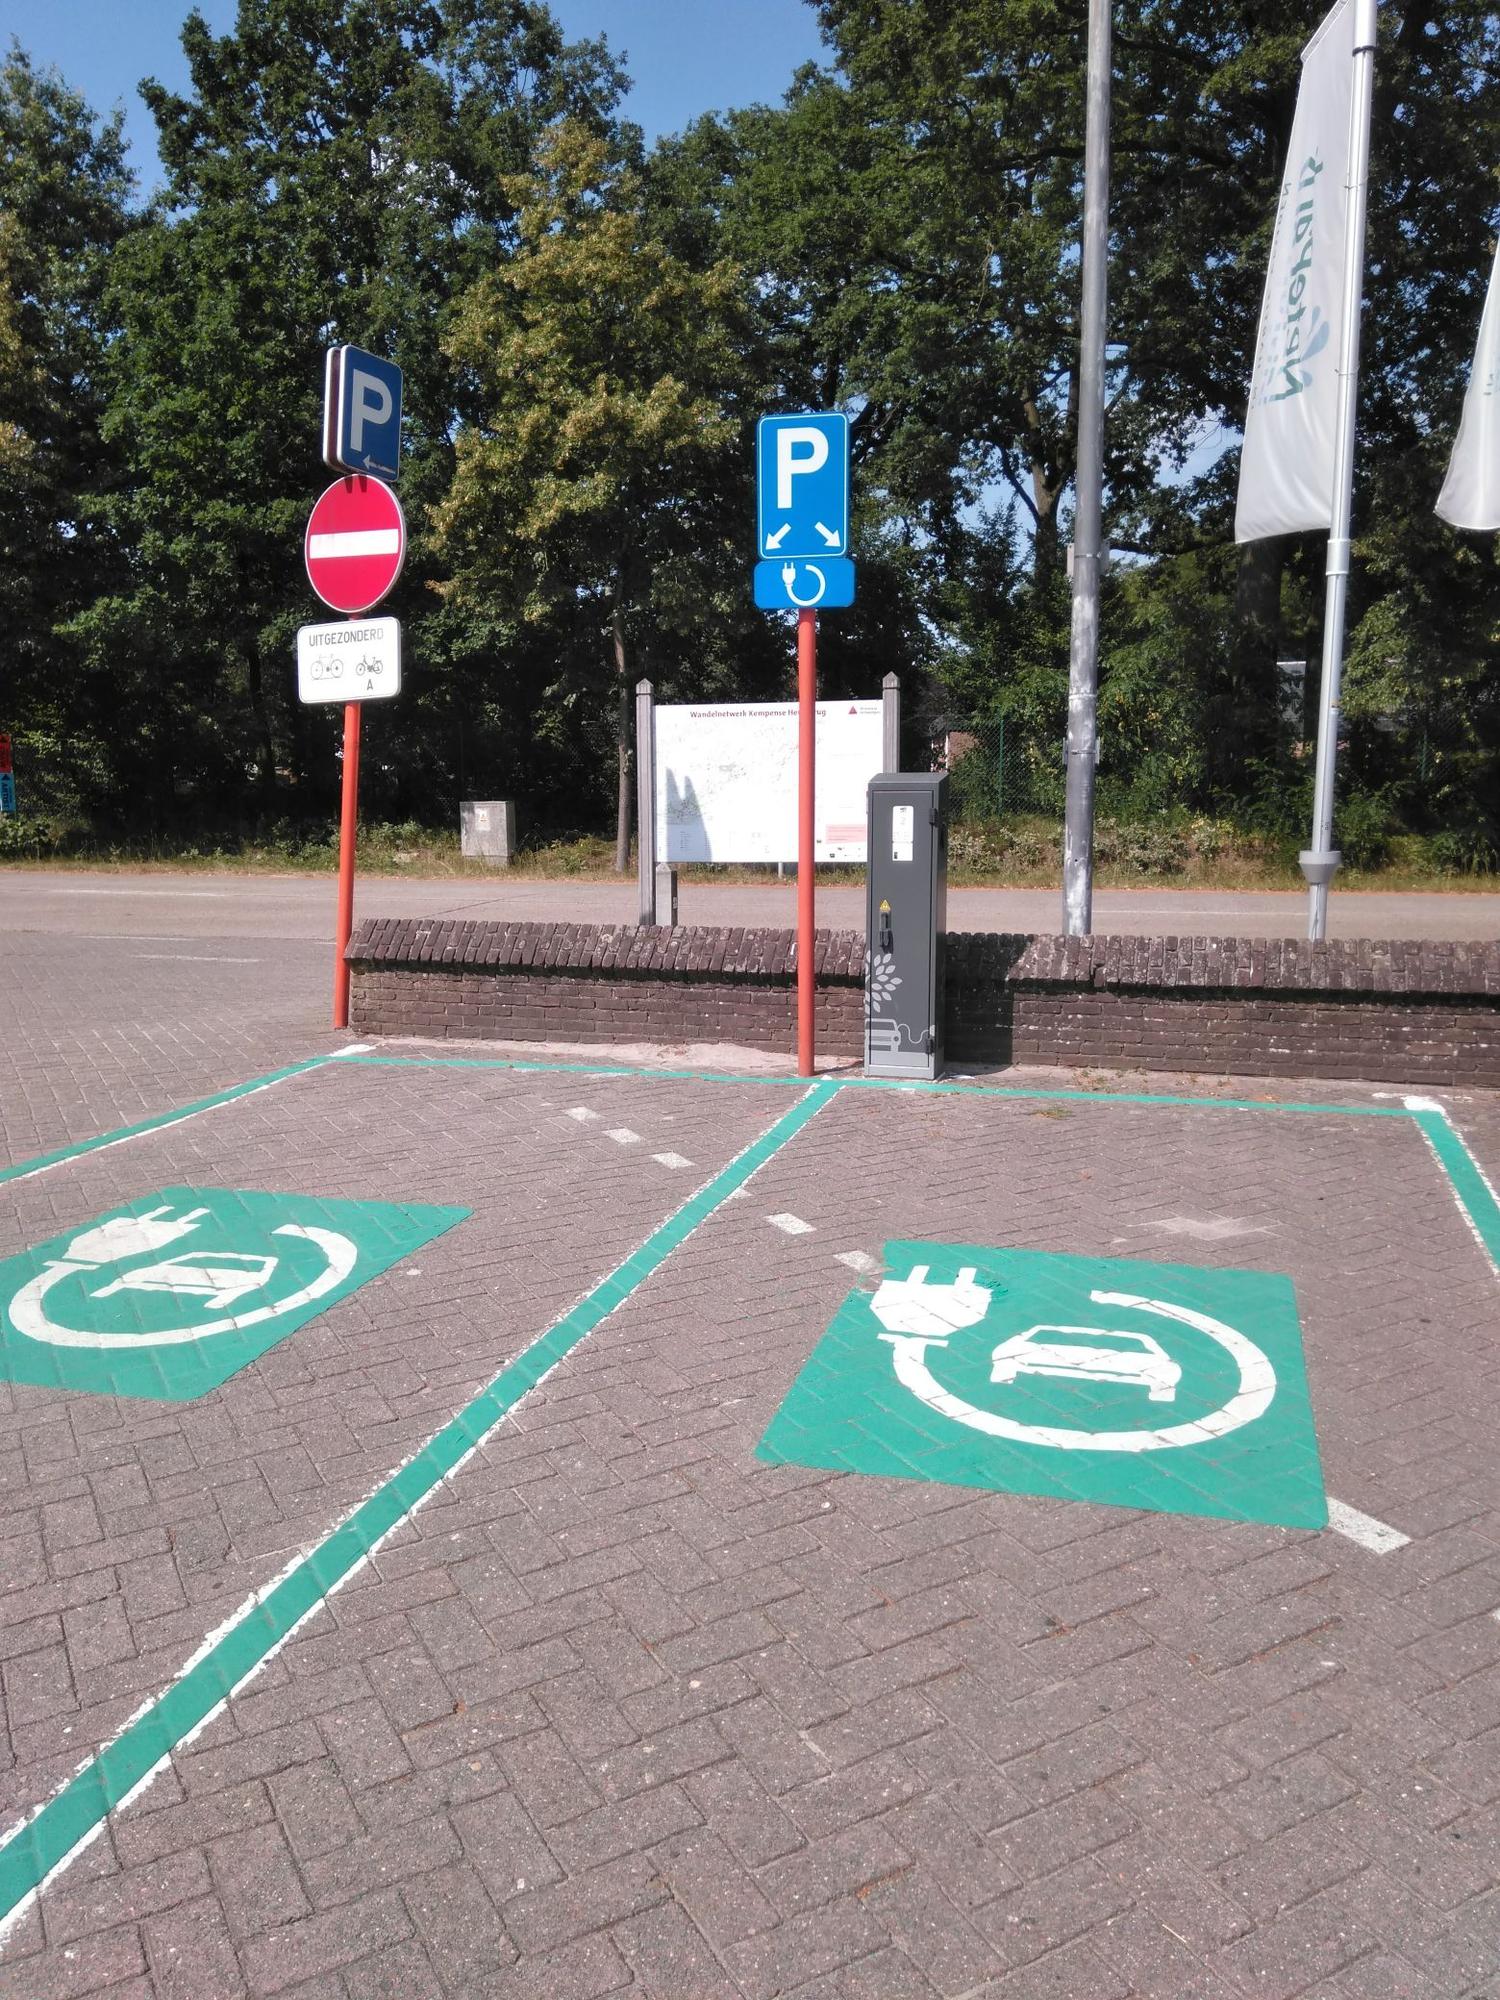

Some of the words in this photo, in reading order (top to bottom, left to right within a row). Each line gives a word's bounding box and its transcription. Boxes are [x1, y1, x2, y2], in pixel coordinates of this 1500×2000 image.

[351, 368, 393, 452] P
[777, 427, 829, 509] P
[309, 628, 384, 647] UITGEZONDERD
[366, 679, 374, 691] A
[690, 710, 747, 718] Wandelnetwerk
[749, 709, 787, 718] Kempense
